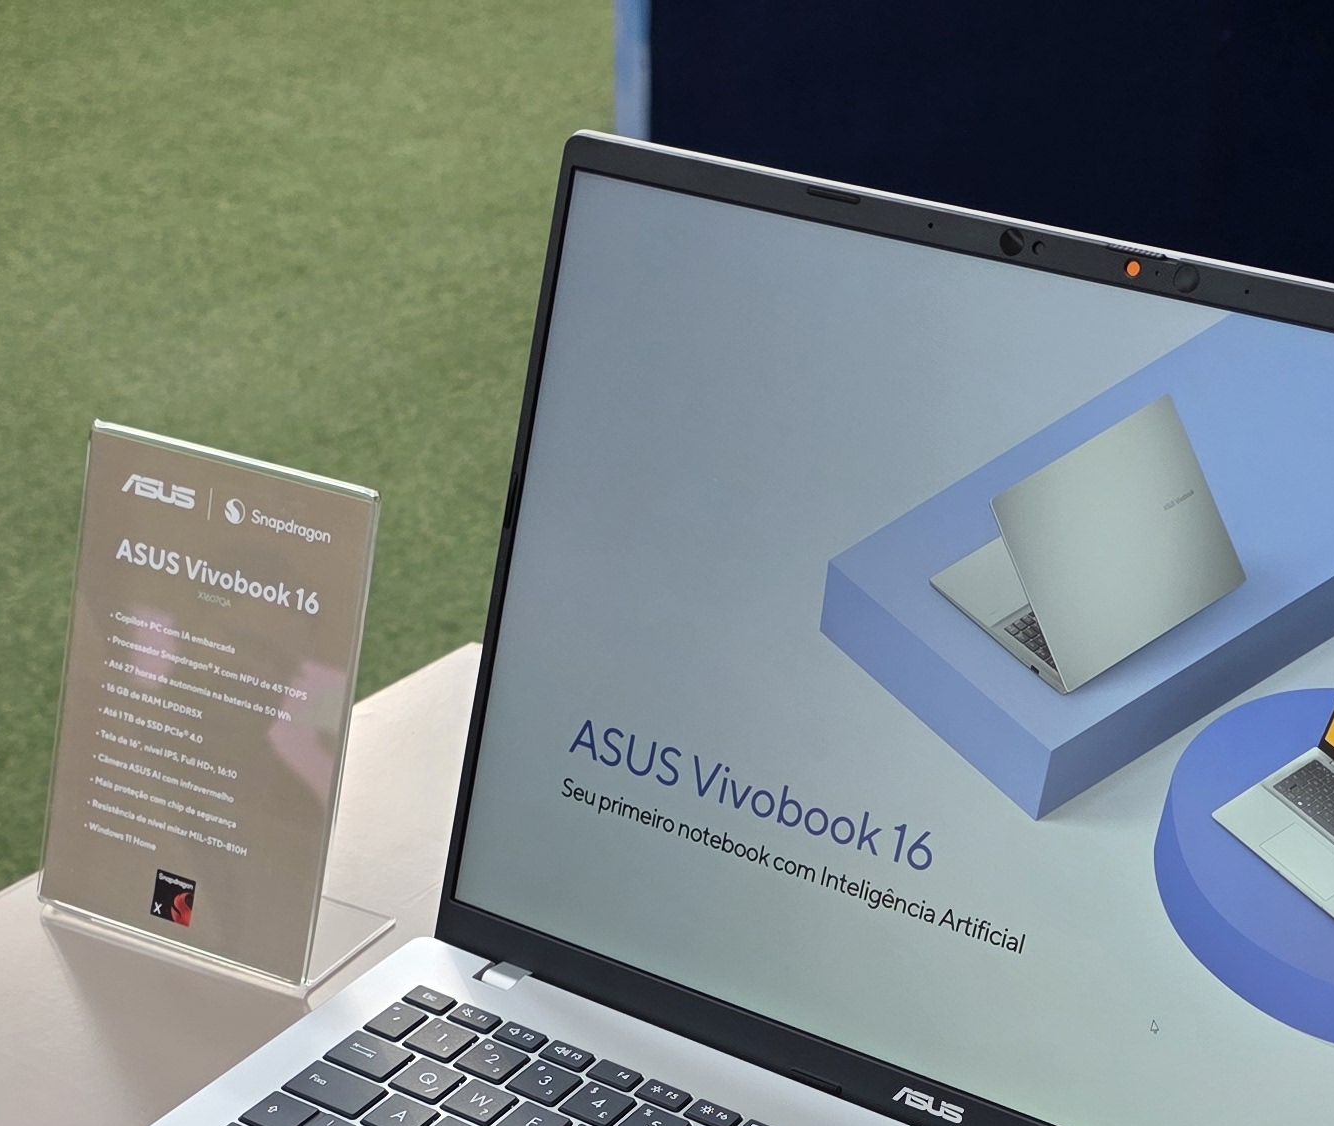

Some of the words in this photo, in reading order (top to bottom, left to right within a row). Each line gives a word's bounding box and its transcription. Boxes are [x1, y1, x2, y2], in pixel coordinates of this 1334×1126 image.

[121, 474, 196, 509] ASUS
[251, 509, 331, 544] Snapdragon
[116, 539, 179, 575] ASUS
[185, 556, 290, 607] Vivobook
[296, 588, 320, 615] 16
[149, 622, 162, 632] PC
[163, 627, 180, 637] com
[181, 631, 190, 641] IA
[192, 635, 235, 654] embarcada
[112, 636, 159, 656] Processador
[214, 666, 220, 675] X
[221, 669, 238, 680] com
[239, 673, 259, 686] NPU
[260, 681, 270, 690] de
[272, 684, 282, 693] 45
[284, 687, 308, 700] TOPS
[107, 683, 115, 692] 16
[116, 686, 129, 697] GB
[130, 691, 140, 700] de
[142, 694, 161, 706] RAM
[163, 700, 203, 719] LPDDR5X
[109, 660, 123, 671] Até
[124, 664, 134, 673] 27
[135, 667, 156, 680] horas
[158, 675, 168, 684] de
[169, 679, 211, 697] autonomia
[212, 691, 222, 700] na
[224, 694, 251, 709] bateria
[253, 703, 263, 713] de
[265, 706, 276, 716] 50
[278, 710, 291, 721] Wh
[103, 707, 117, 718] Até
[119, 711, 122, 719] 1
[124, 712, 134, 723] TB
[135, 717, 145, 726] de
[147, 720, 163, 731] SSD
[189, 733, 203, 744] 4.0
[100, 729, 116, 742] Tela
[118, 736, 127, 745] de
[181, 754, 195, 766] Full
[129, 763, 151, 777] ASUS
[162, 775, 179, 785] com
[95, 776, 113, 789] Mais
[150, 795, 166, 806] com
[167, 800, 184, 813] chip
[185, 806, 196, 815] de
[569, 719, 683, 786] ASUS
[694, 755, 882, 857] Vivobook
[893, 824, 933, 871] 16
[89, 822, 124, 841] Windows
[125, 833, 132, 843] 11
[133, 837, 157, 851] Home
[136, 814, 146, 824] de
[561, 778, 596, 806] Seu
[597, 794, 675, 833] primeiro
[678, 822, 771, 867] notebook
[773, 853, 816, 883] com
[820, 867, 936, 924] Inteligência
[938, 908, 1026, 954] Artificial
[153, 901, 162, 915] X
[419, 1073, 437, 1084] Q
[390, 1111, 406, 1122] A
[470, 1093, 493, 1107] W
[892, 1087, 965, 1124] ASUS
